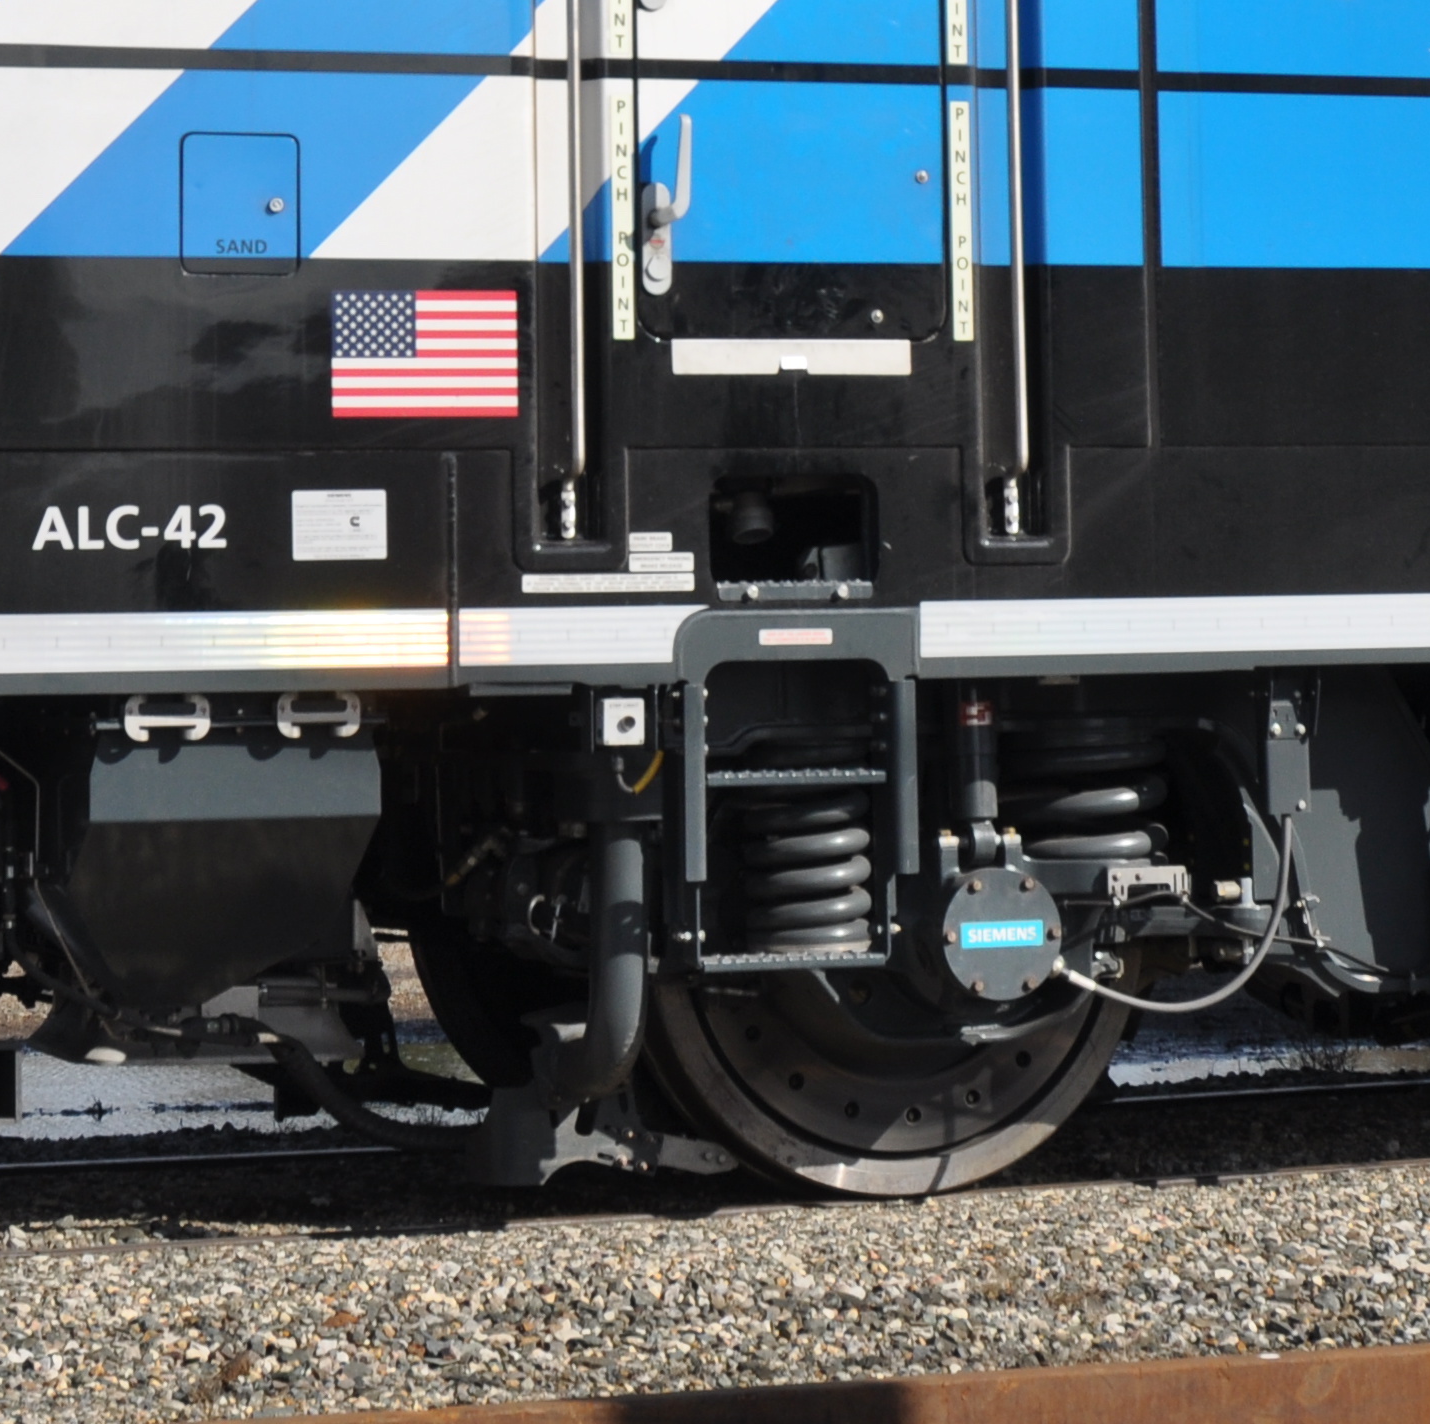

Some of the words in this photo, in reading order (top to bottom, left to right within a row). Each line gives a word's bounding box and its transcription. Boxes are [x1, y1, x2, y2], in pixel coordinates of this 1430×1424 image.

[616, 99, 629, 203] PINCH
[954, 108, 967, 206] PINCH
[215, 239, 268, 255] SAND
[618, 232, 630, 334] POINT
[957, 236, 969, 336] POINT
[32, 504, 227, 551] ALC-42
[968, 926, 1037, 943] SIEMENS
